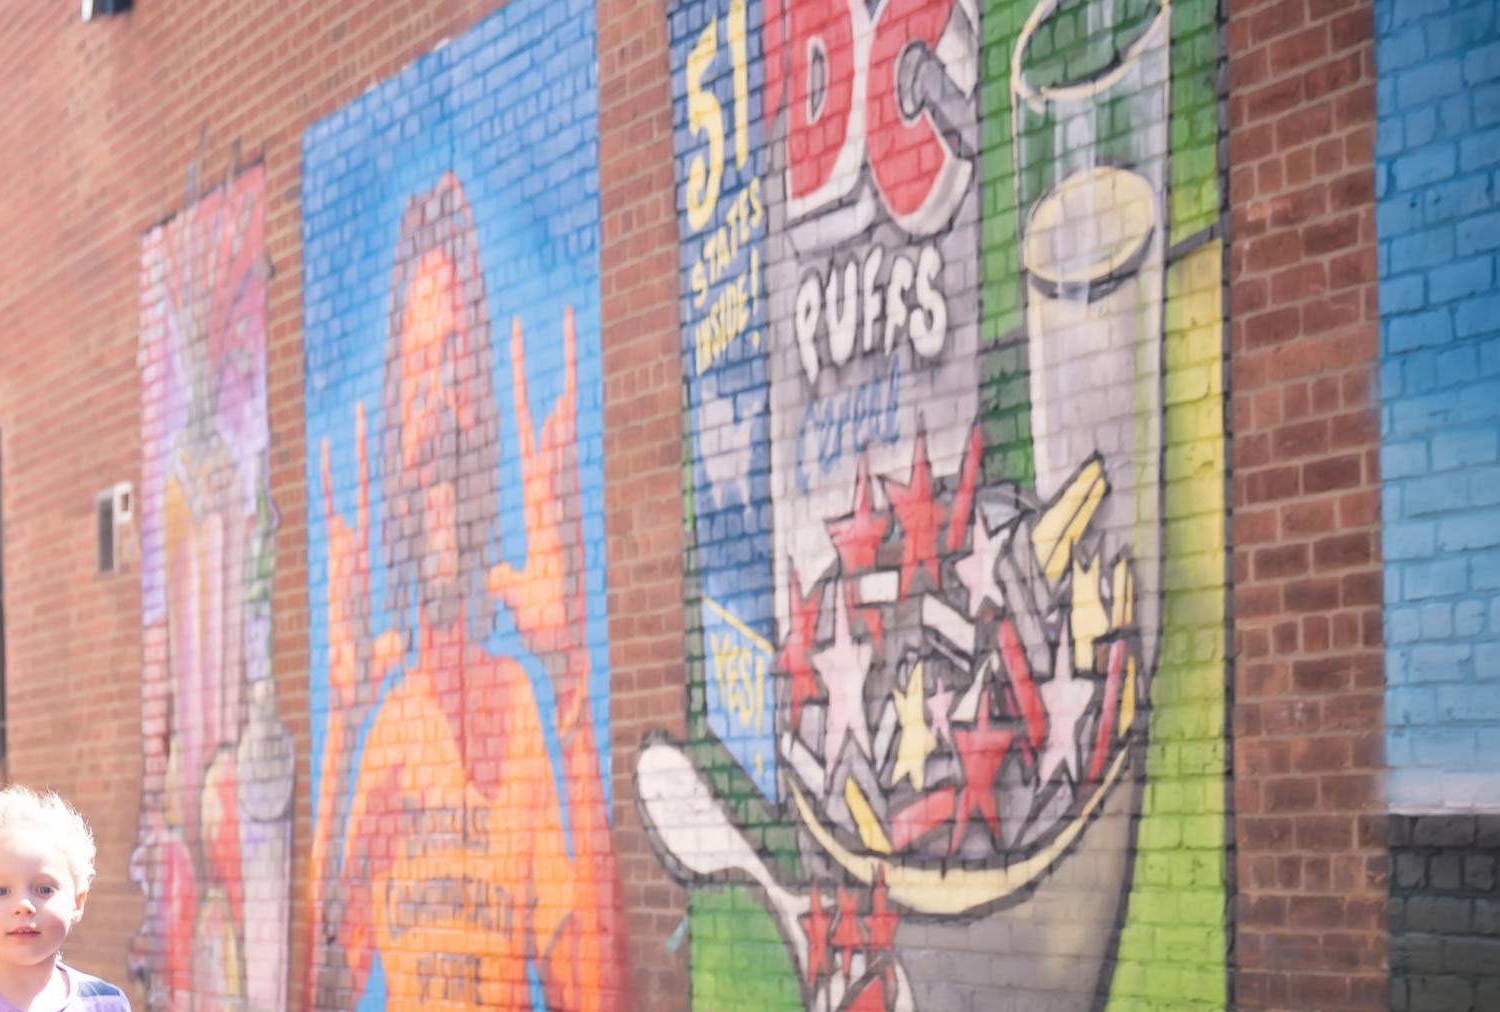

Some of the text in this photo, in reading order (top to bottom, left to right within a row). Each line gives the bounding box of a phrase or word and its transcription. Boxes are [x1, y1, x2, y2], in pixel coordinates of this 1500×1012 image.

[686, 0, 749, 232] 51
[786, 0, 972, 236] DC
[691, 176, 764, 310] STATES
[794, 244, 948, 386] PUFFS
[710, 631, 765, 778] YES!
